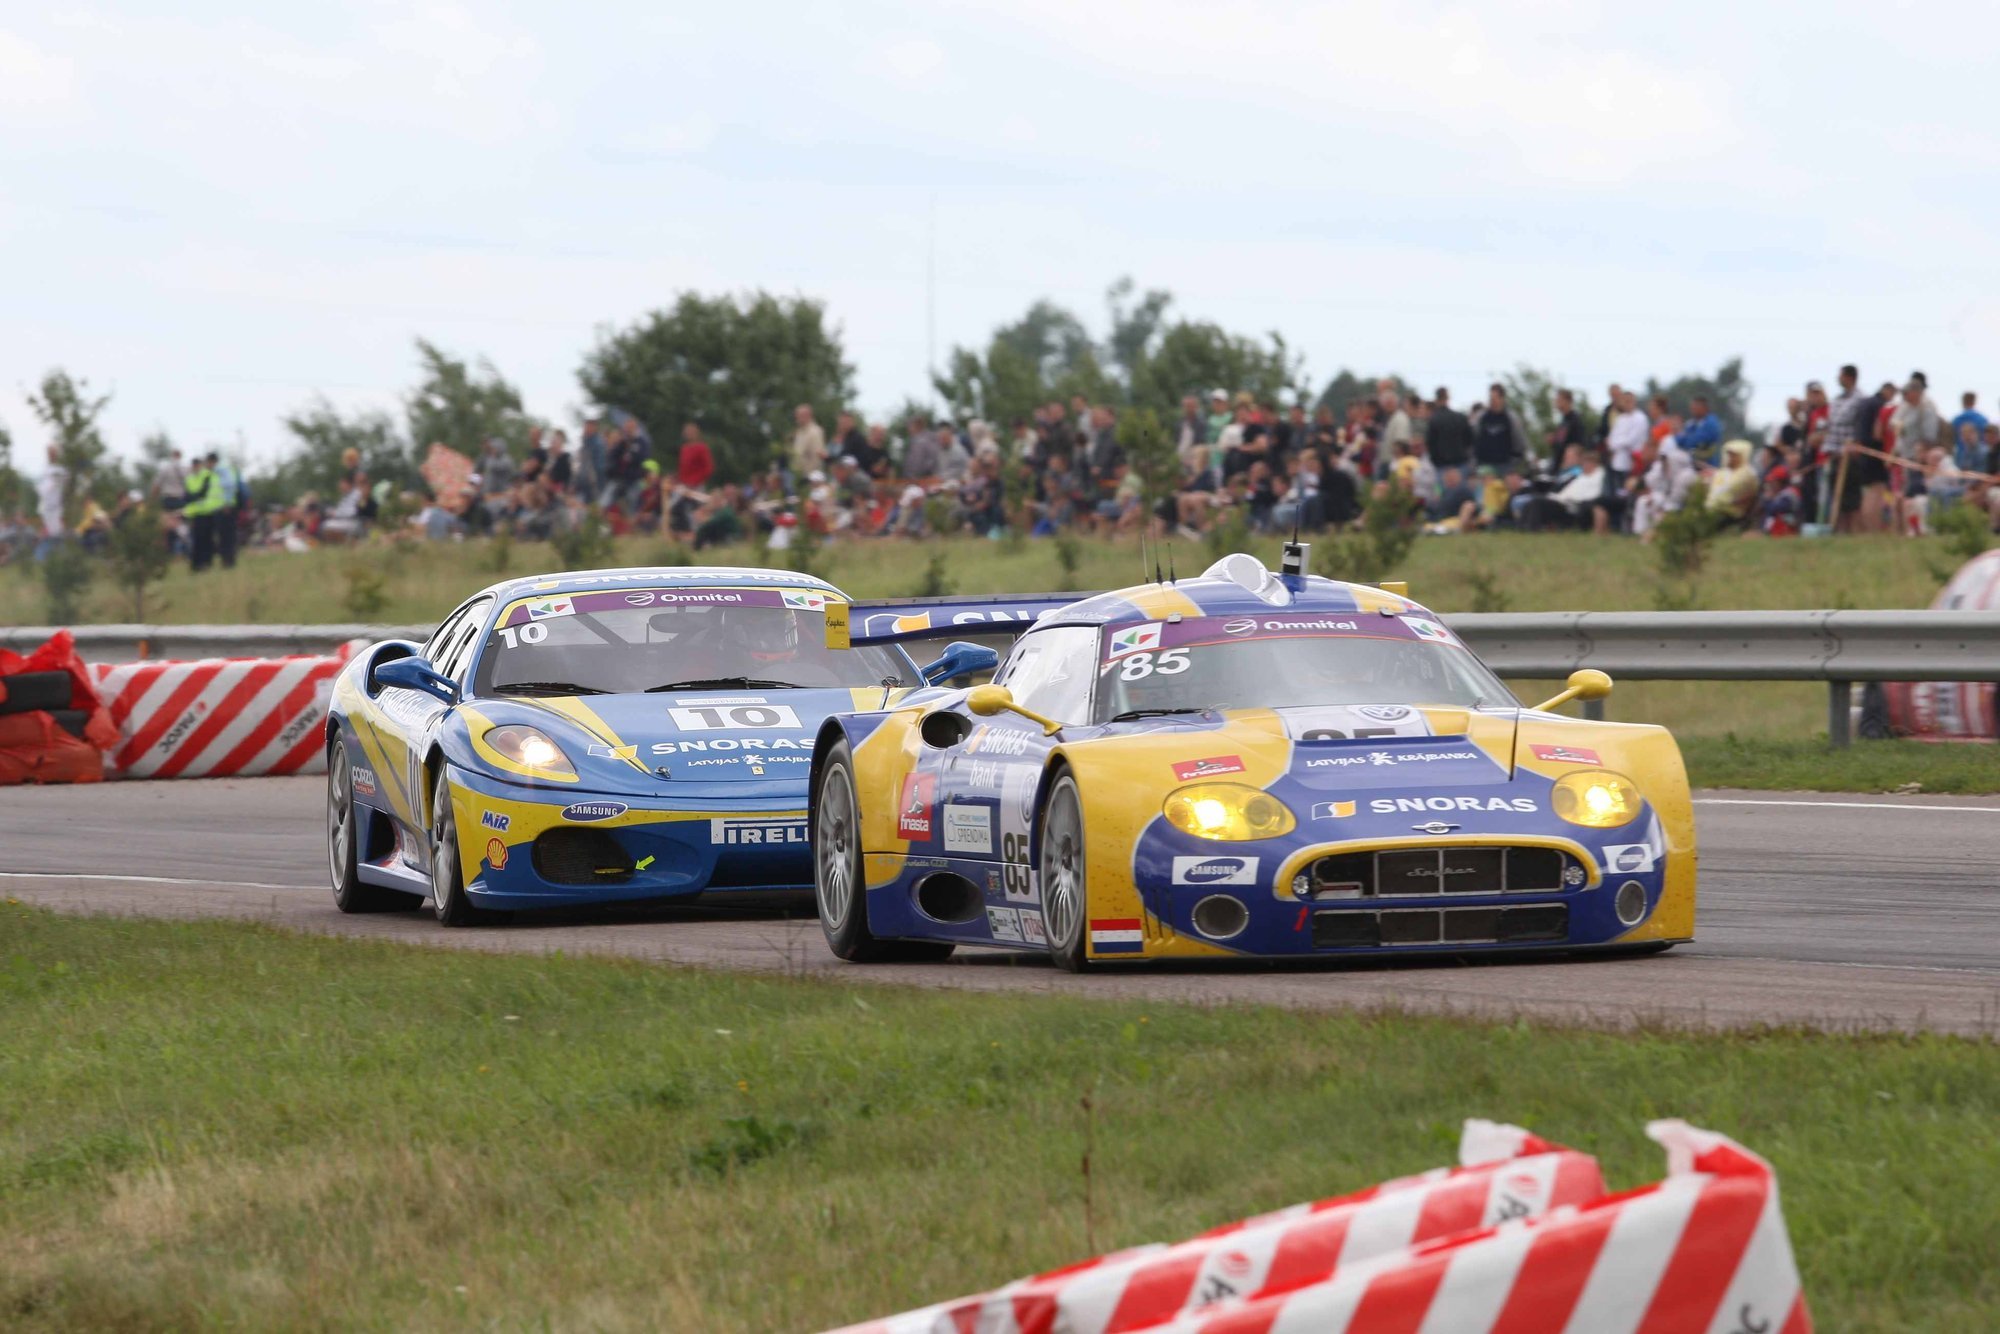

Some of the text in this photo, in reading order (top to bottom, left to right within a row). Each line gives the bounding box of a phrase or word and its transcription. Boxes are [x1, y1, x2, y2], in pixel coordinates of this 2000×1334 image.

[660, 593, 743, 603] Omnitel
[1263, 619, 1358, 632] Omnitel
[498, 622, 548, 650] 10
[1120, 648, 1191, 682] 85
[688, 706, 781, 728] 10
[651, 738, 816, 755] SNORAS
[979, 728, 1036, 756] SNORAS
[687, 757, 740, 767] LATVIJAS
[1306, 752, 1478, 767] LATVIJAS KRĀJBANKA
[969, 759, 998, 789] bank
[570, 805, 618, 816] SAMSUNG
[1371, 796, 1538, 814] SNORAS
[711, 818, 809, 845] PIREL
[900, 813, 929, 832] finasta
[1003, 832, 1031, 896] 85
[1190, 865, 1238, 875] SAMSUNG
